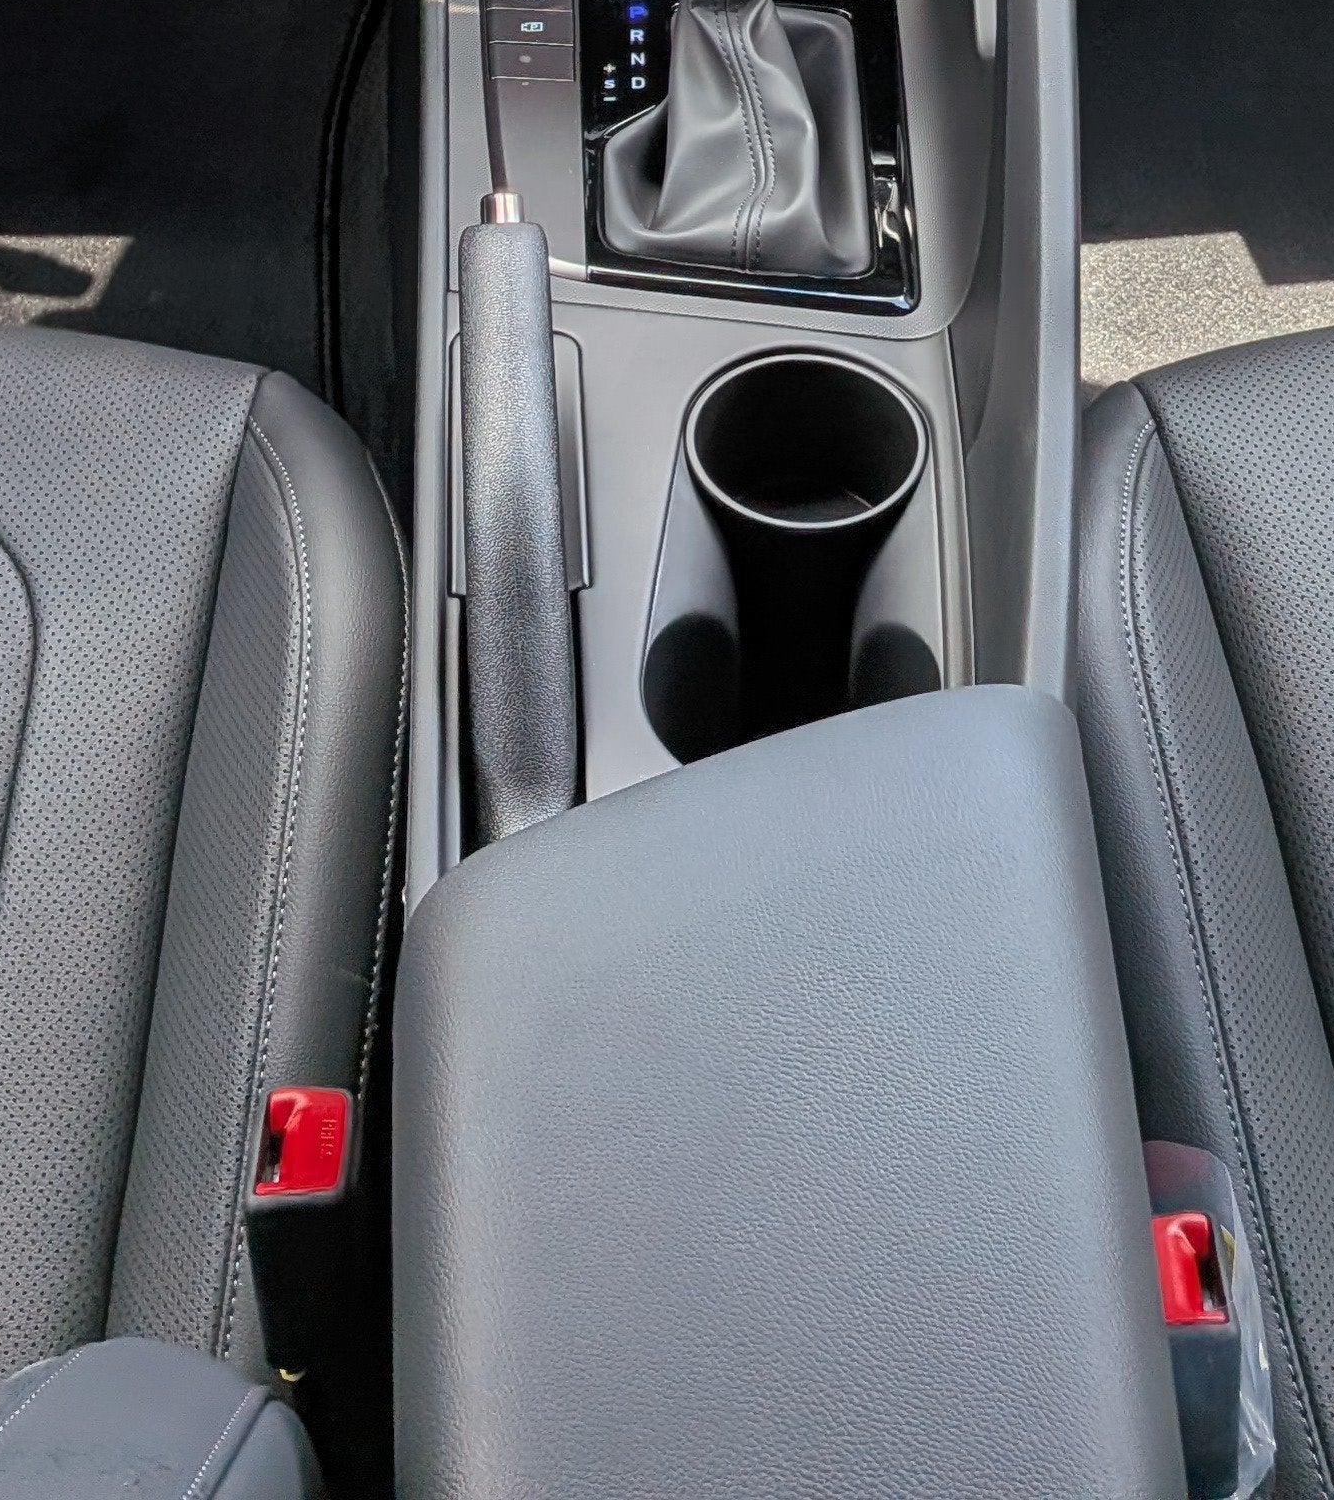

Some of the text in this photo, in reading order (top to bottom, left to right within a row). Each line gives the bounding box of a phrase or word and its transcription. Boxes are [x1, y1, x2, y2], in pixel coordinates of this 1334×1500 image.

[629, 5, 649, 20] P
[630, 28, 645, 43] R
[631, 51, 646, 66] N
[631, 76, 646, 90] D
